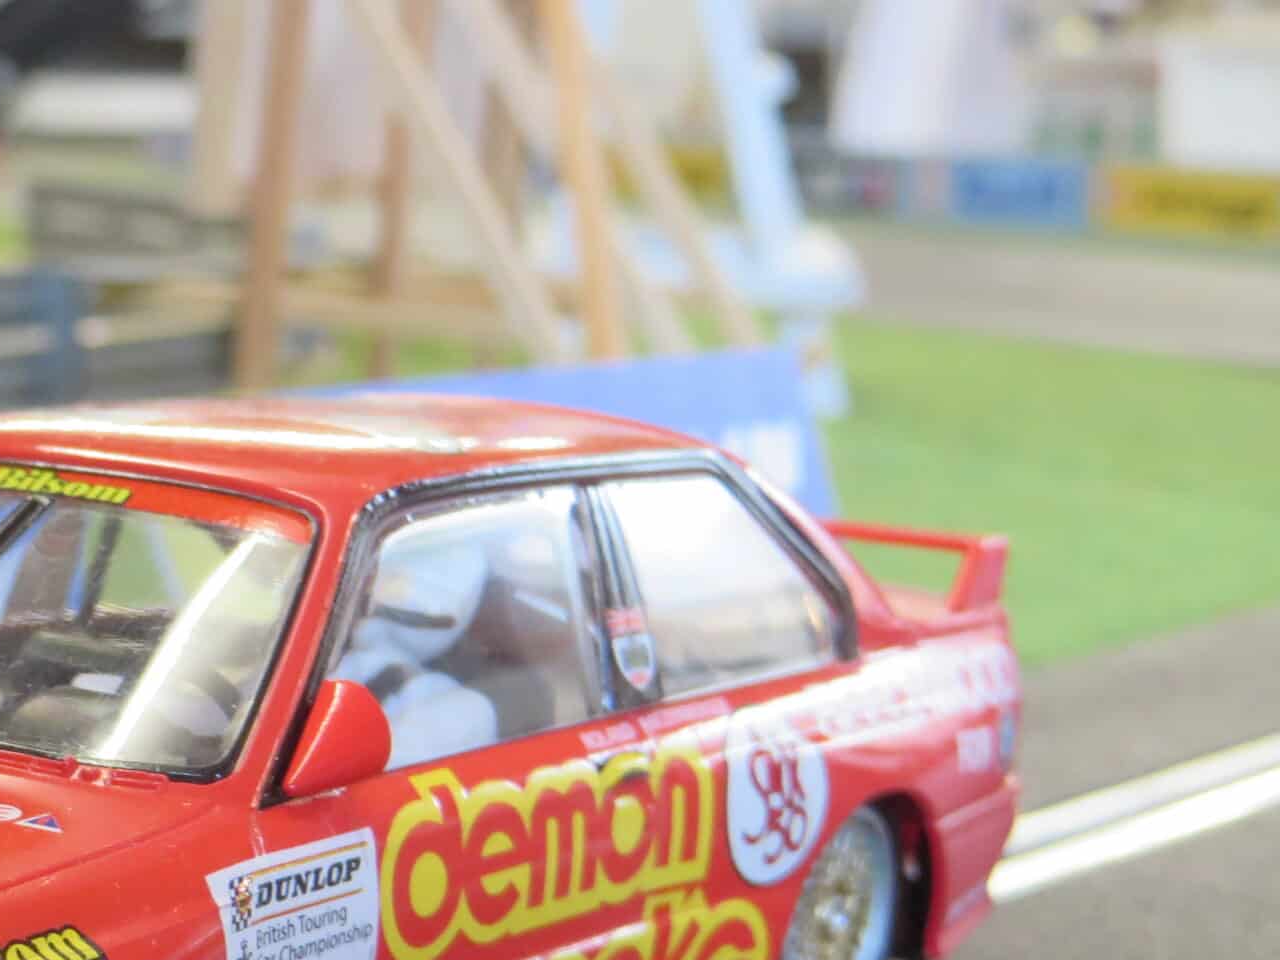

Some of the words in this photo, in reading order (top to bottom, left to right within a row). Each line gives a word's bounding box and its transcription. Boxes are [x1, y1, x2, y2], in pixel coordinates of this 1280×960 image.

[255, 856, 361, 909] DUNLOP
[255, 919, 296, 950] British
[297, 905, 348, 936] Touring
